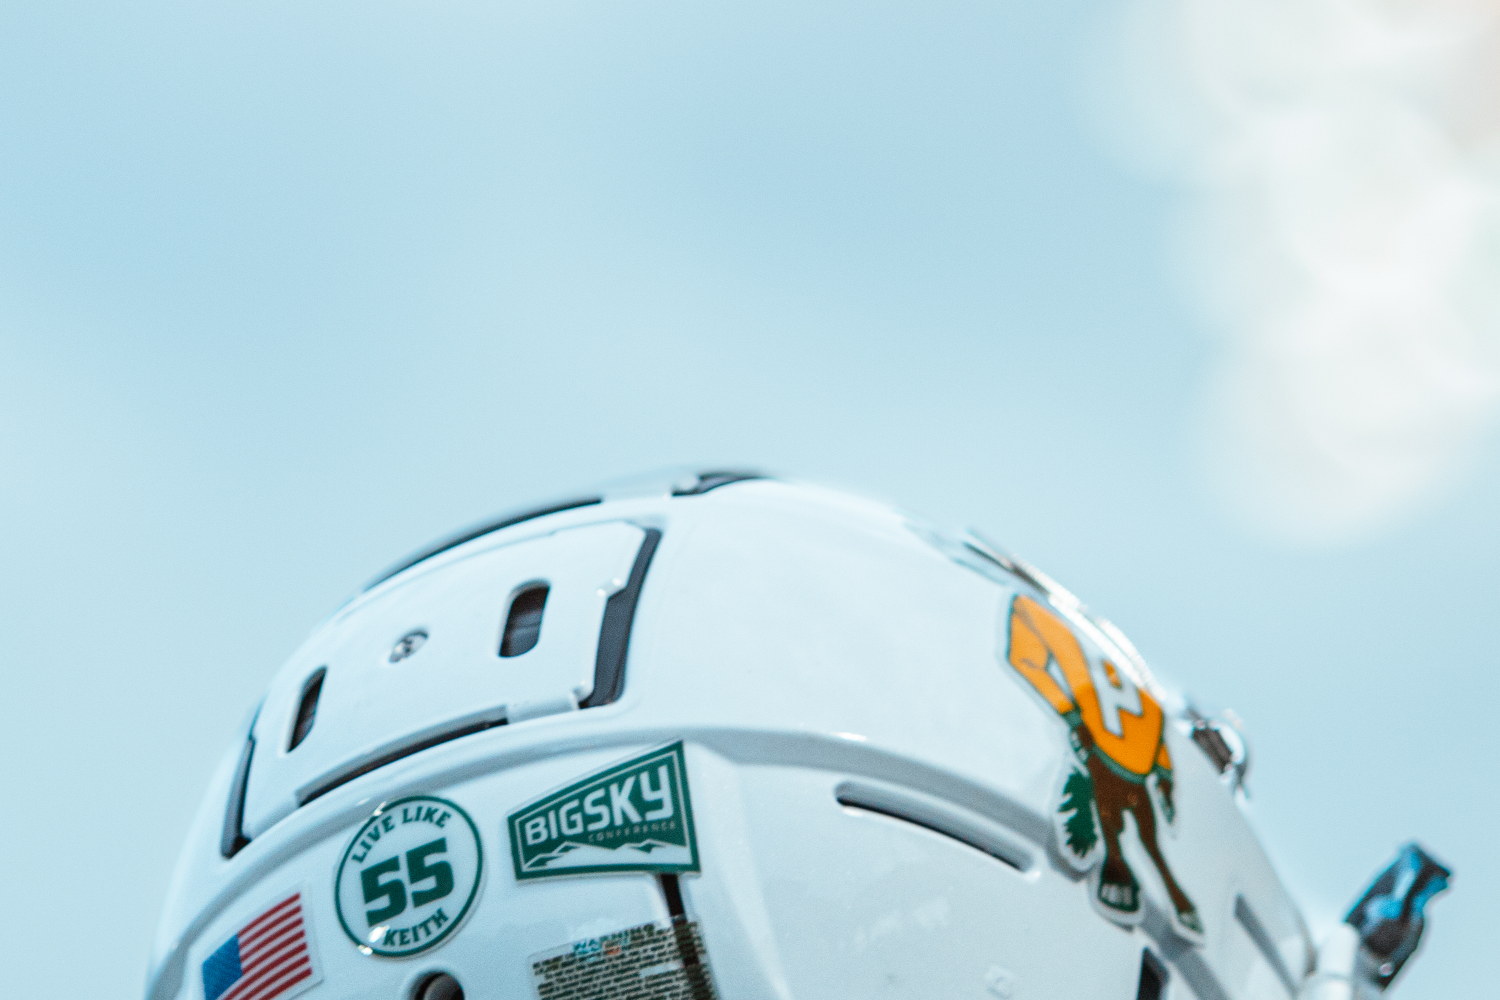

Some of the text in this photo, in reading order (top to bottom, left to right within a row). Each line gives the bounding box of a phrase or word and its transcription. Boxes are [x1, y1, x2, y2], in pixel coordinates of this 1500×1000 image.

[351, 805, 451, 863] LIVE LIKE
[588, 820, 676, 843] CONFERENCE
[360, 836, 454, 928] 55
[383, 907, 449, 946] KEITH
